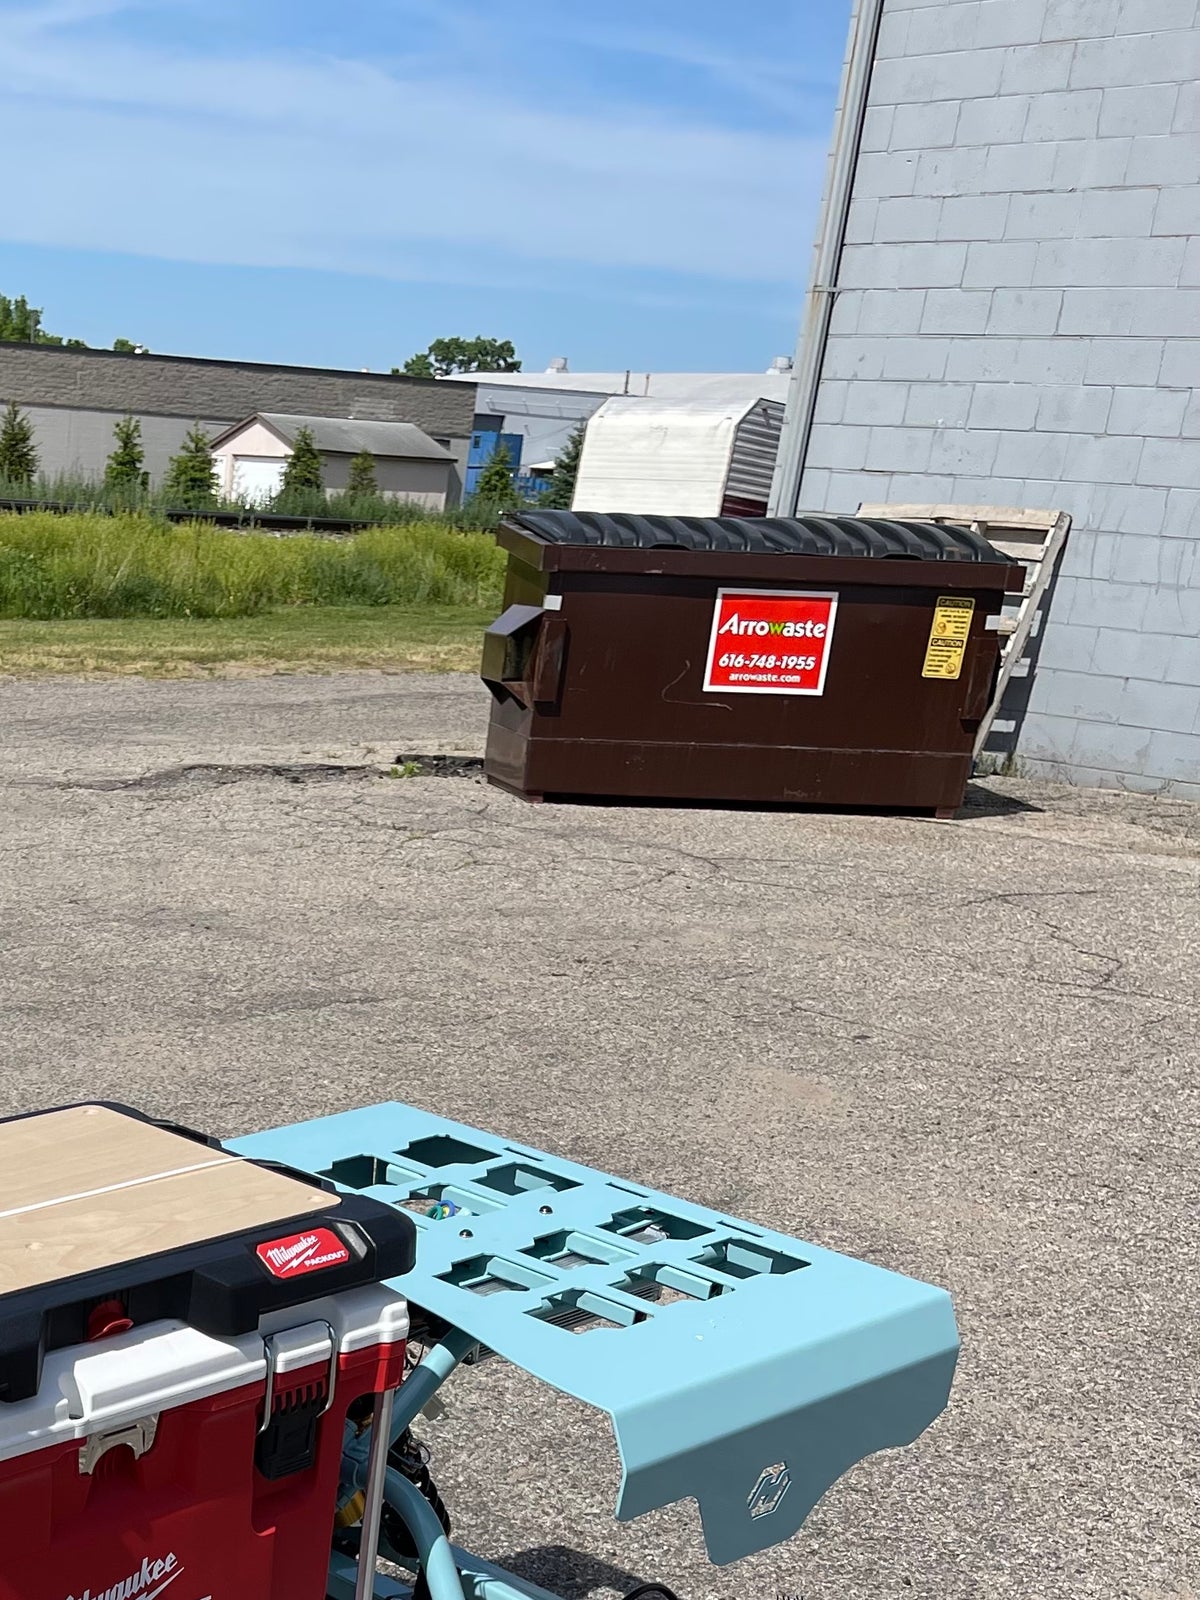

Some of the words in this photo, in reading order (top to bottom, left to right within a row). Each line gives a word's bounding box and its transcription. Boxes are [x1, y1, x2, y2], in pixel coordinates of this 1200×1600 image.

[940, 599, 971, 608] CAUTION
[718, 612, 827, 639] Arrowaste
[932, 639, 963, 647] CAUTION
[718, 653, 817, 671] 616-748-1955
[728, 672, 801, 684] arrowaste.com
[266, 1234, 319, 1268] Milwaukee
[303, 1250, 347, 1267] PACKOUT
